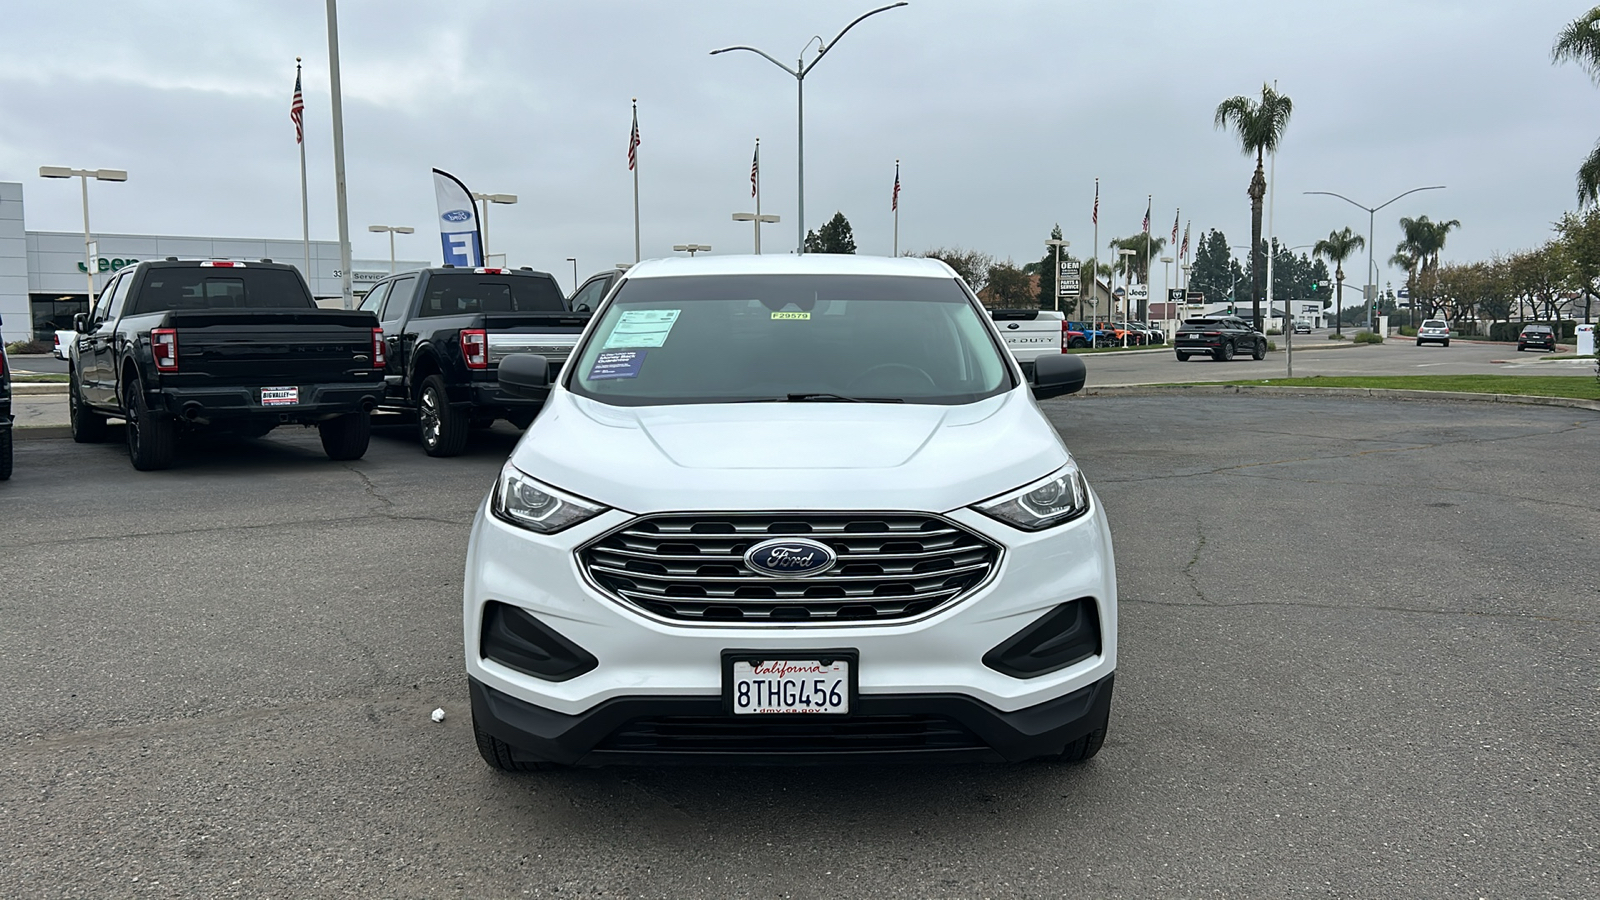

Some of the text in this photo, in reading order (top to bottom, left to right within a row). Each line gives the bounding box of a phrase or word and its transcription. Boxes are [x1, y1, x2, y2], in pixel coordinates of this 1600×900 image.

[1128, 289, 1147, 297] Jeep
[766, 547, 814, 567] Ford
[754, 660, 828, 678] California
[737, 679, 842, 708] 8THG456
